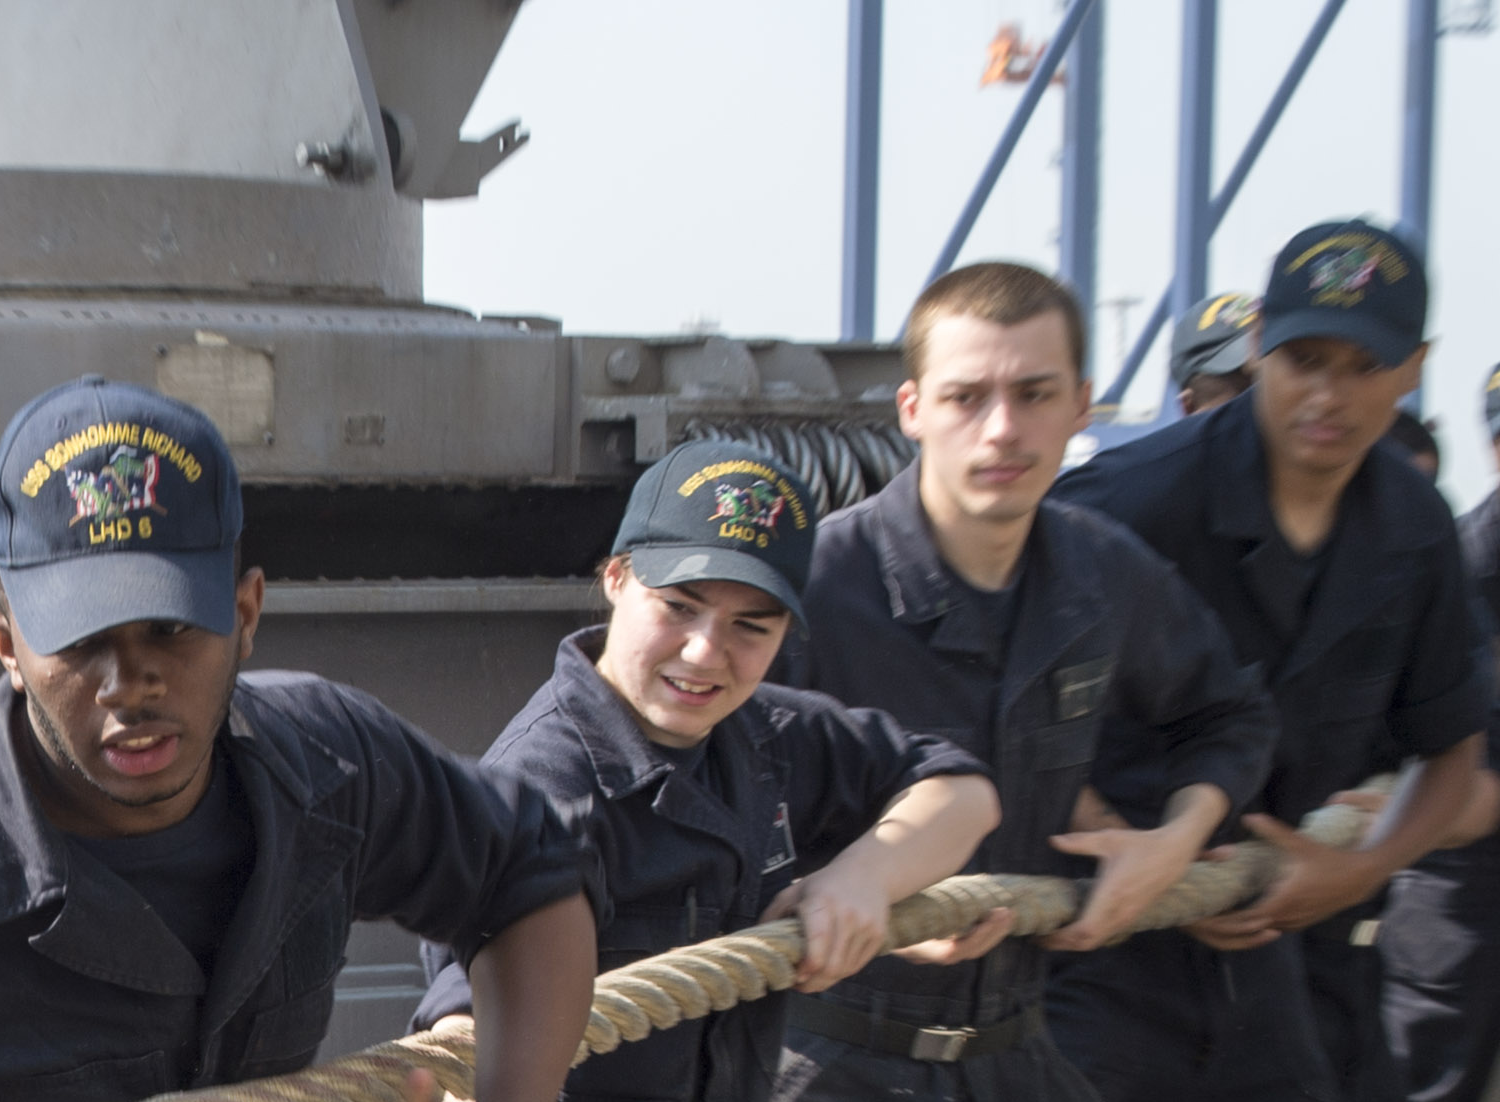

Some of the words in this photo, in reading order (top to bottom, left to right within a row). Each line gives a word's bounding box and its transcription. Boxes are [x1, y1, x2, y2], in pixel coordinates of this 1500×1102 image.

[20, 459, 50, 498] USS
[45, 422, 140, 471] BONHOMME
[142, 427, 202, 483] RICHARD
[89, 517, 132, 544] LHD
[138, 516, 153, 539] 6
[719, 522, 755, 542] LHD
[756, 533, 769, 548] 6
